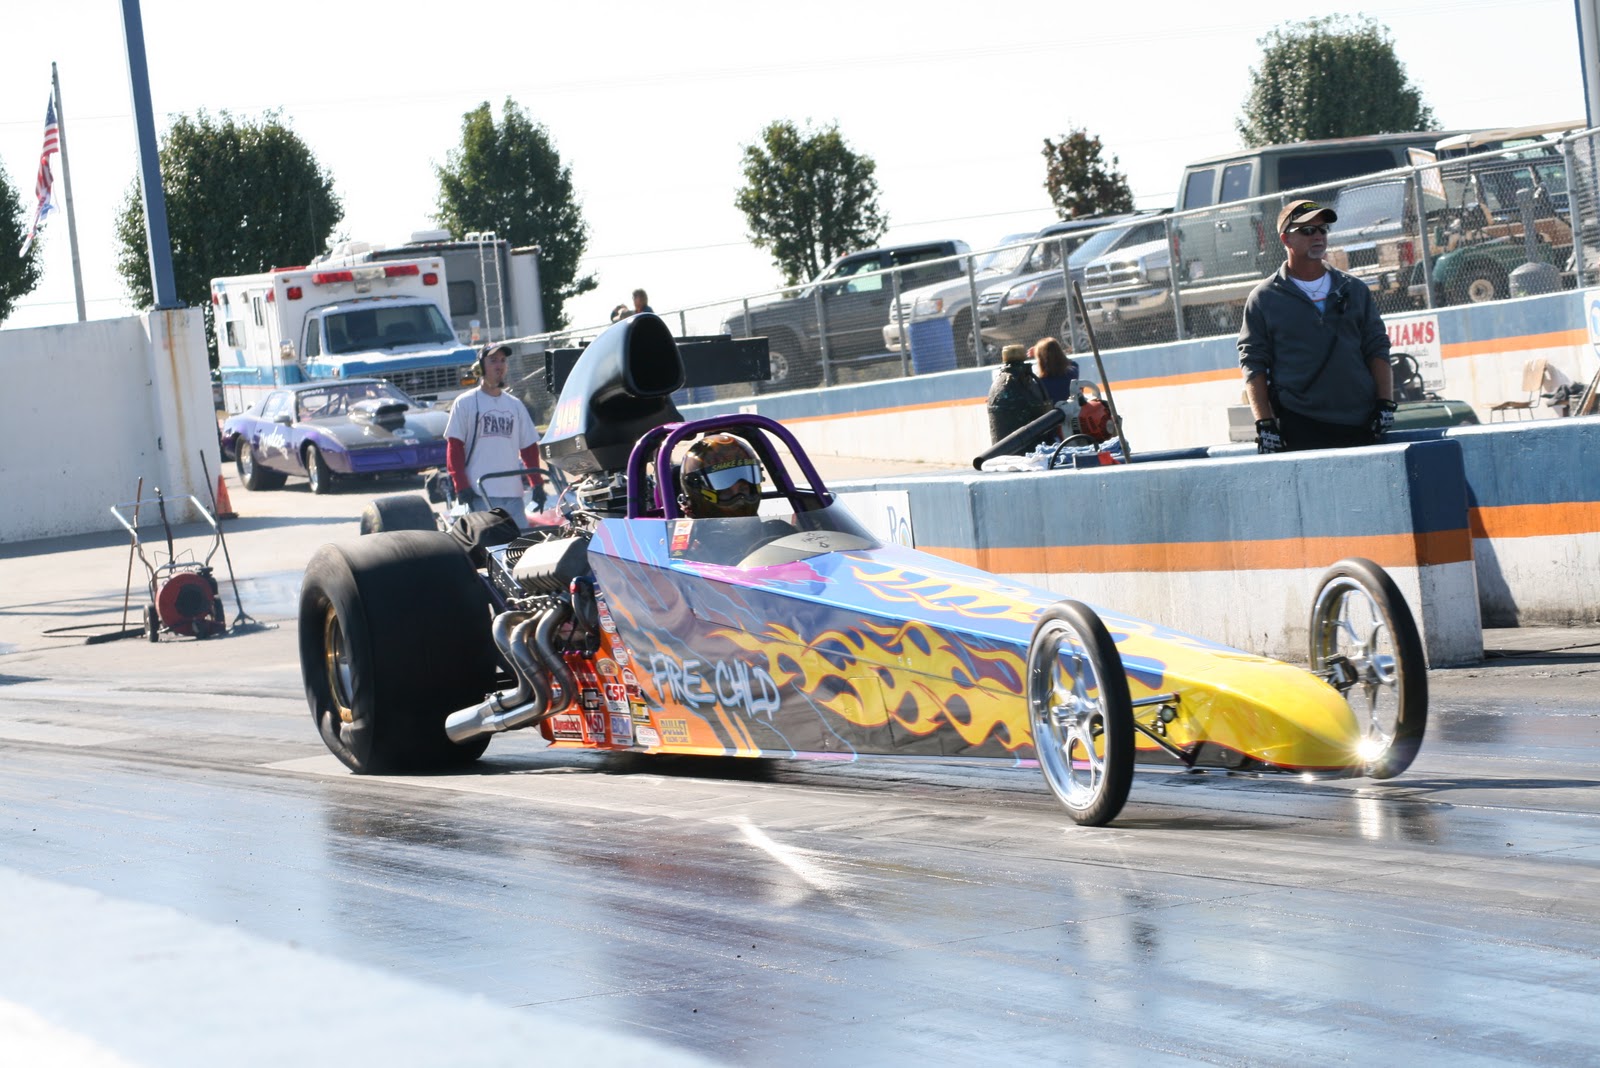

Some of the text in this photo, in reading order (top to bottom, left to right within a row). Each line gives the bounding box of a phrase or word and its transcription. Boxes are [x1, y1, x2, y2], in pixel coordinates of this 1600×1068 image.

[1387, 321, 1435, 347] LIAMS
[606, 684, 626, 702] CSR
[553, 716, 581, 733] Dynatech
[585, 713, 604, 733] MSD
